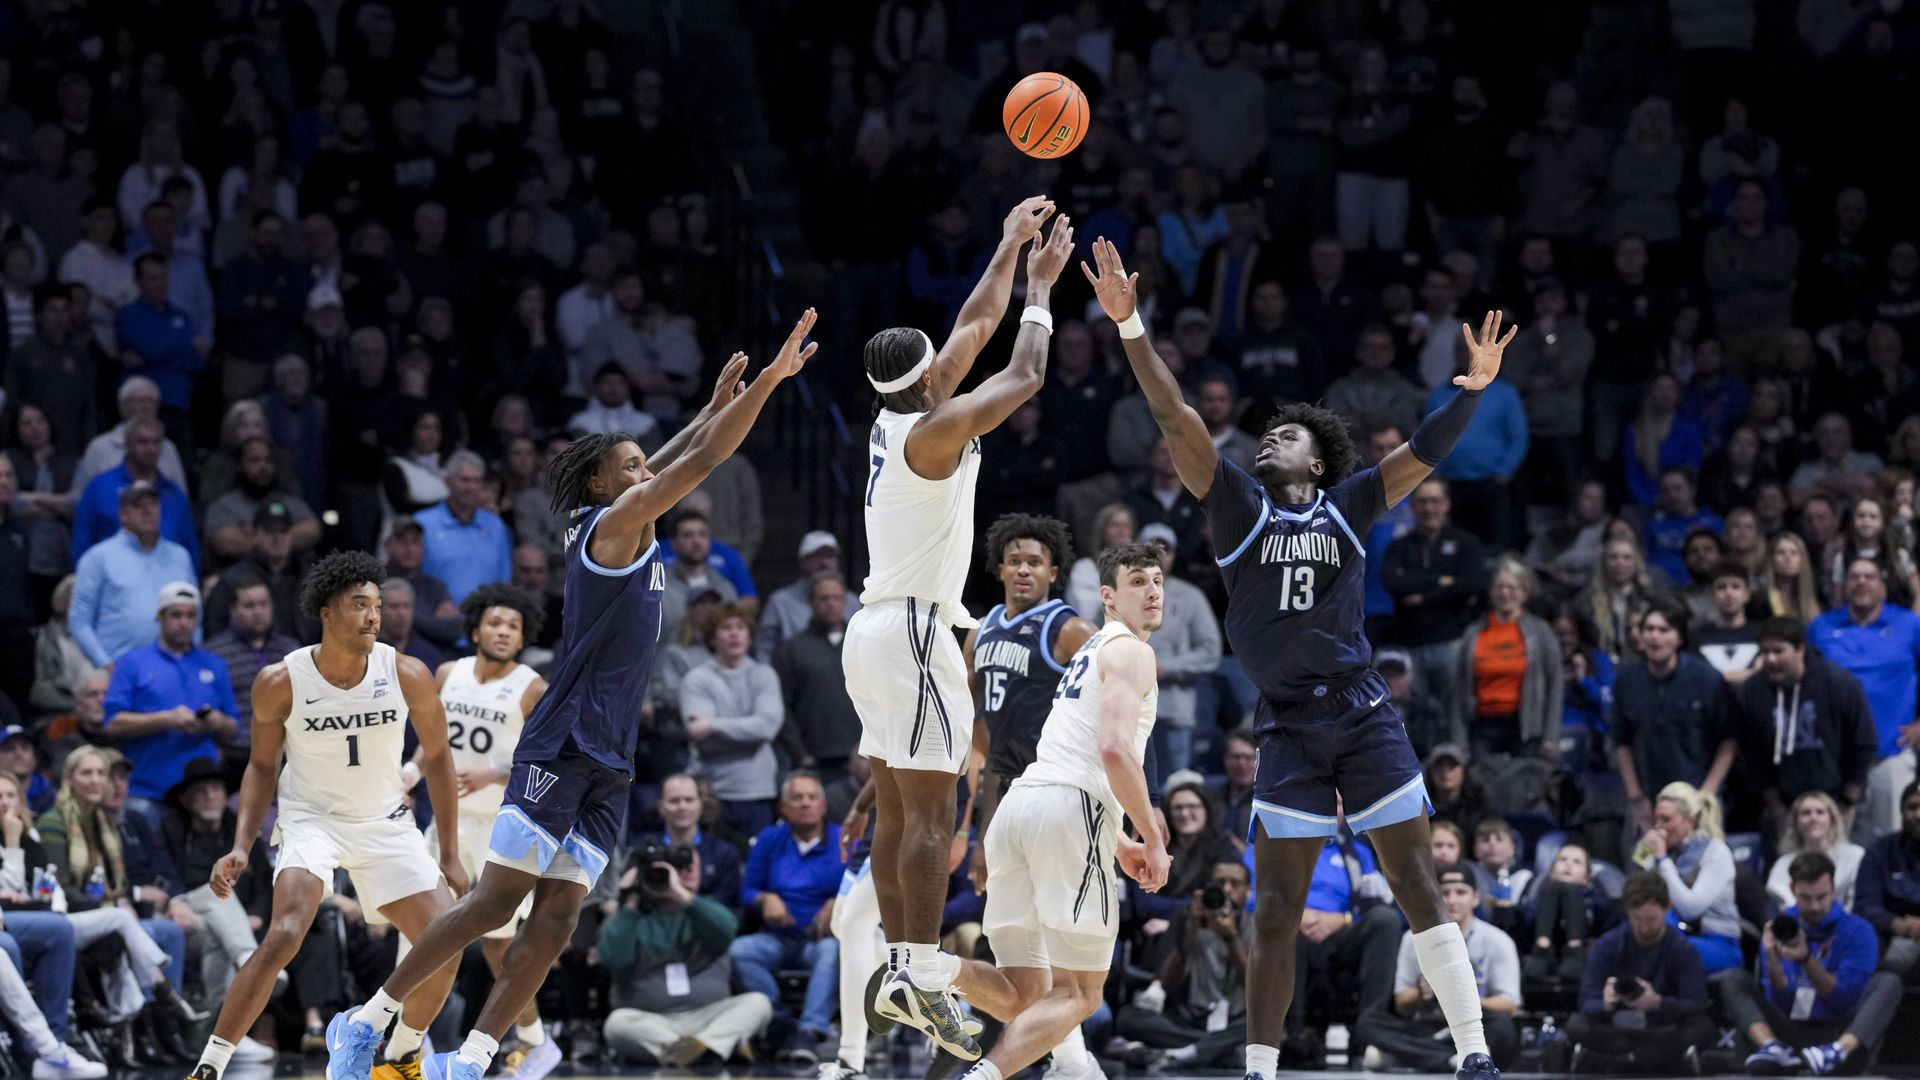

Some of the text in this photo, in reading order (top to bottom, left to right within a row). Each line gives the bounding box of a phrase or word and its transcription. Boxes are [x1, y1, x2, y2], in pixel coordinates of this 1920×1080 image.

[1037, 124, 1071, 156] ELITE
[866, 454, 885, 508] 7
[1260, 532, 1341, 568] VILLANOVA
[1278, 566, 1315, 611] 13
[974, 640, 1031, 677] VILLANOVA
[984, 671, 1008, 711] 15
[304, 709, 397, 732] XAVIER
[445, 700, 508, 724] XAVIER
[345, 735, 361, 767] 1
[448, 721, 493, 754] 20
